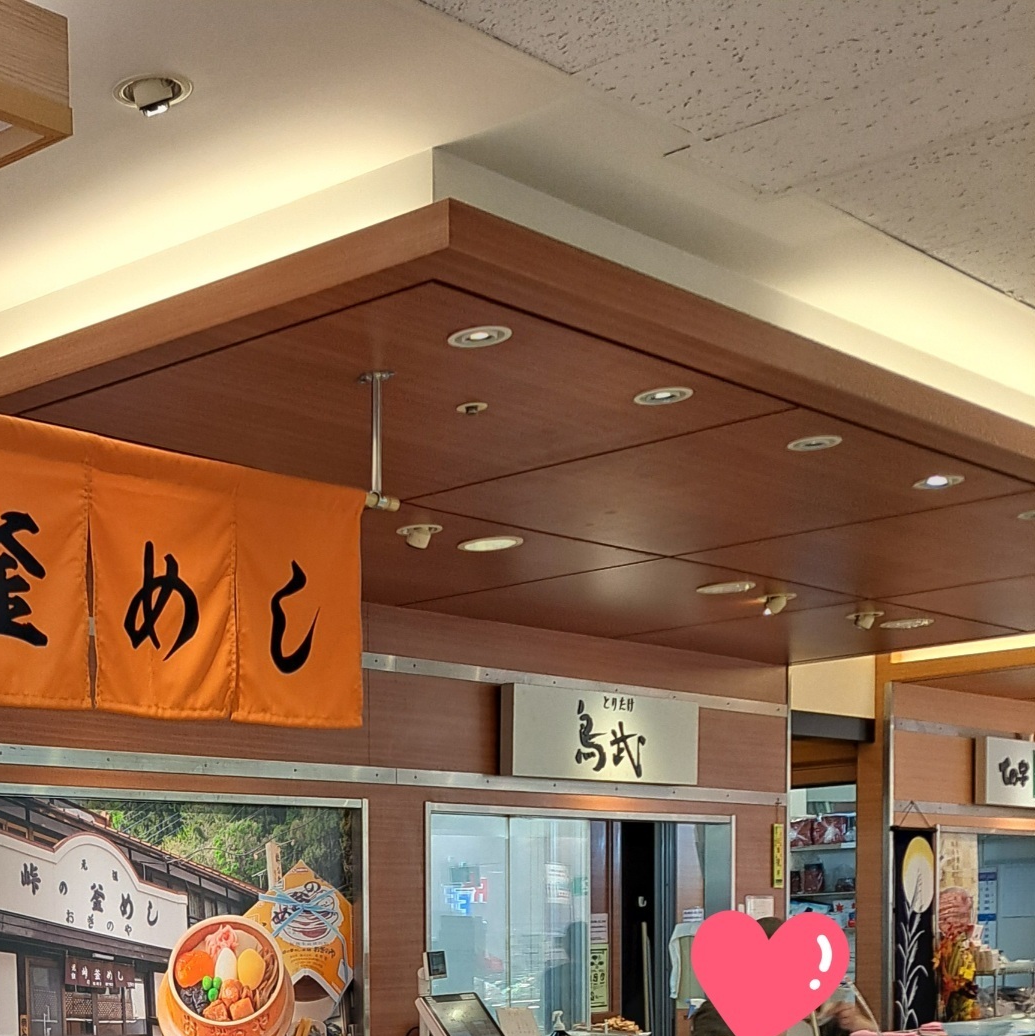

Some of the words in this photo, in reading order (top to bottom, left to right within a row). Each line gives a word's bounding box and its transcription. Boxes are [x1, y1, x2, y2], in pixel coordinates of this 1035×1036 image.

[603, 695, 635, 713] とりたけ
[20, 863, 159, 927] 峠の釜めし
[65, 909, 133, 937] おぎのや
